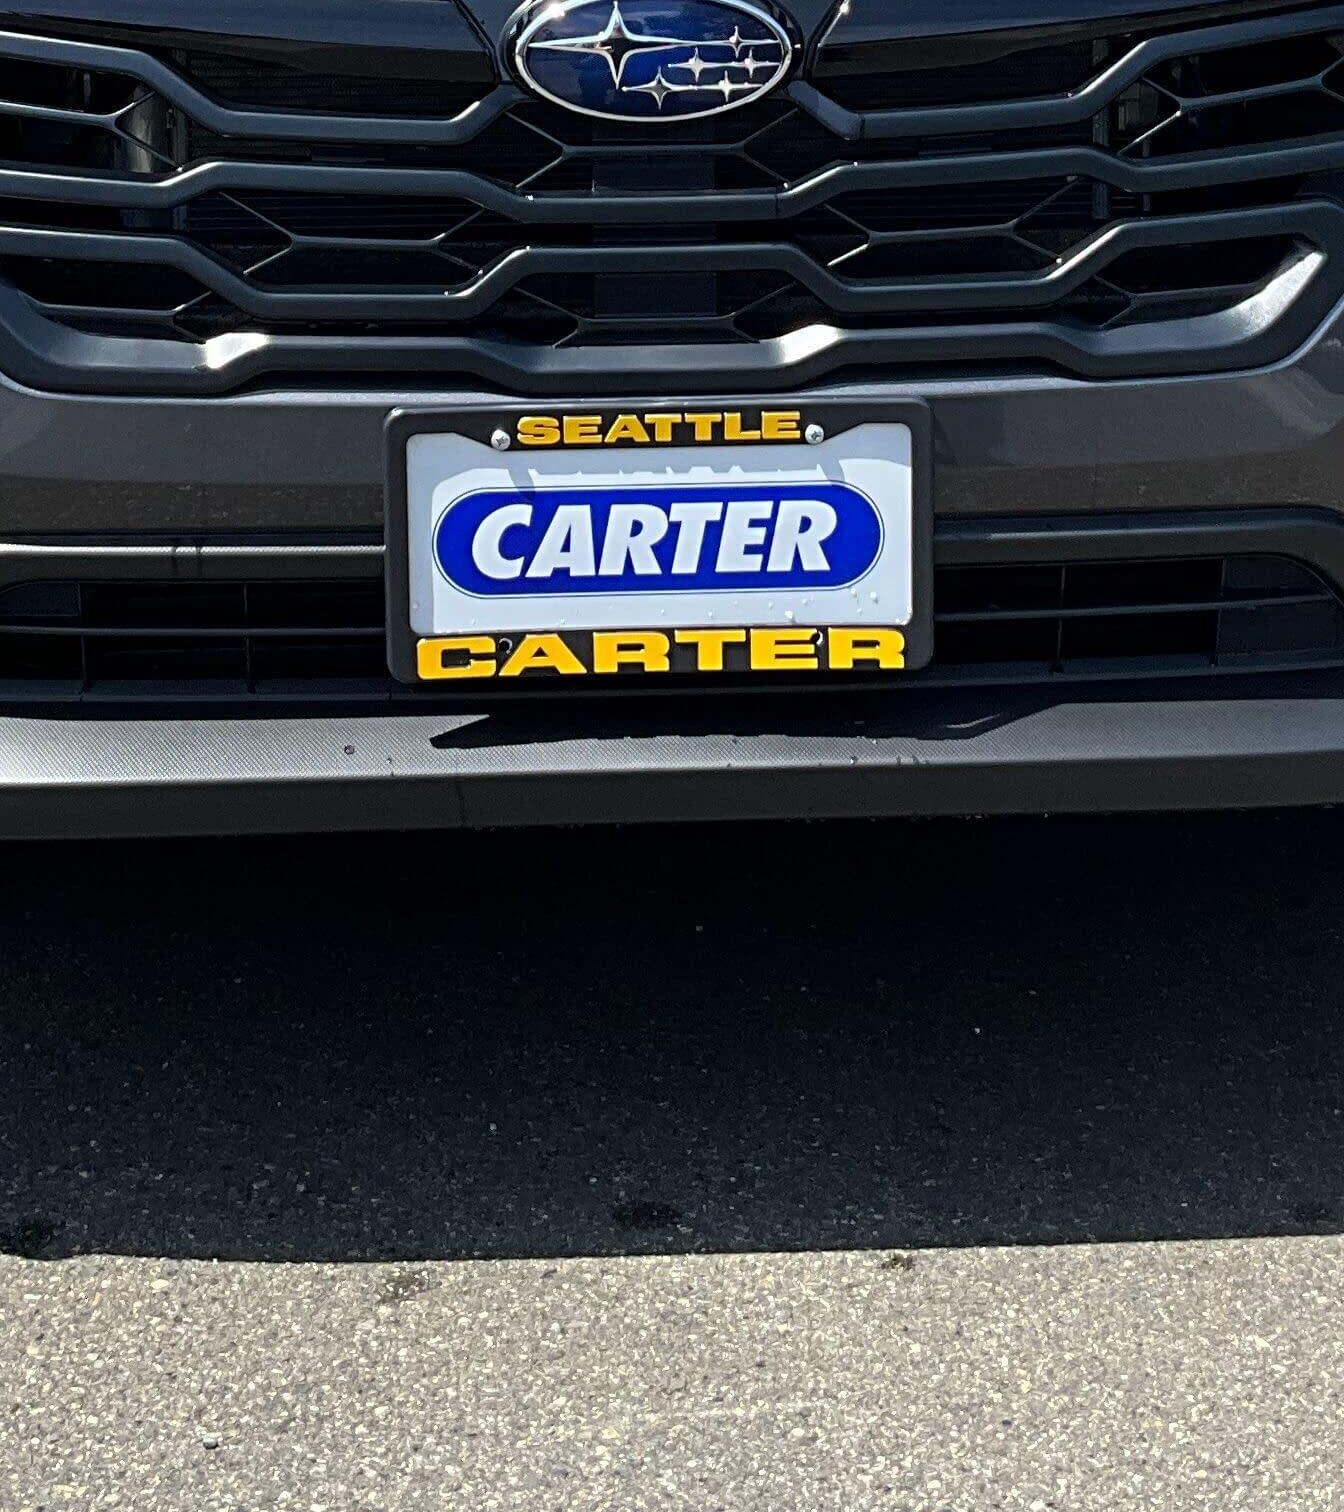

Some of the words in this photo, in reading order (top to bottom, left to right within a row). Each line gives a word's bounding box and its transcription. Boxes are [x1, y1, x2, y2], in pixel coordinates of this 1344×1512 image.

[516, 410, 802, 446] SEATTLE
[471, 499, 838, 581] CARTER
[416, 627, 906, 680] CARTER
